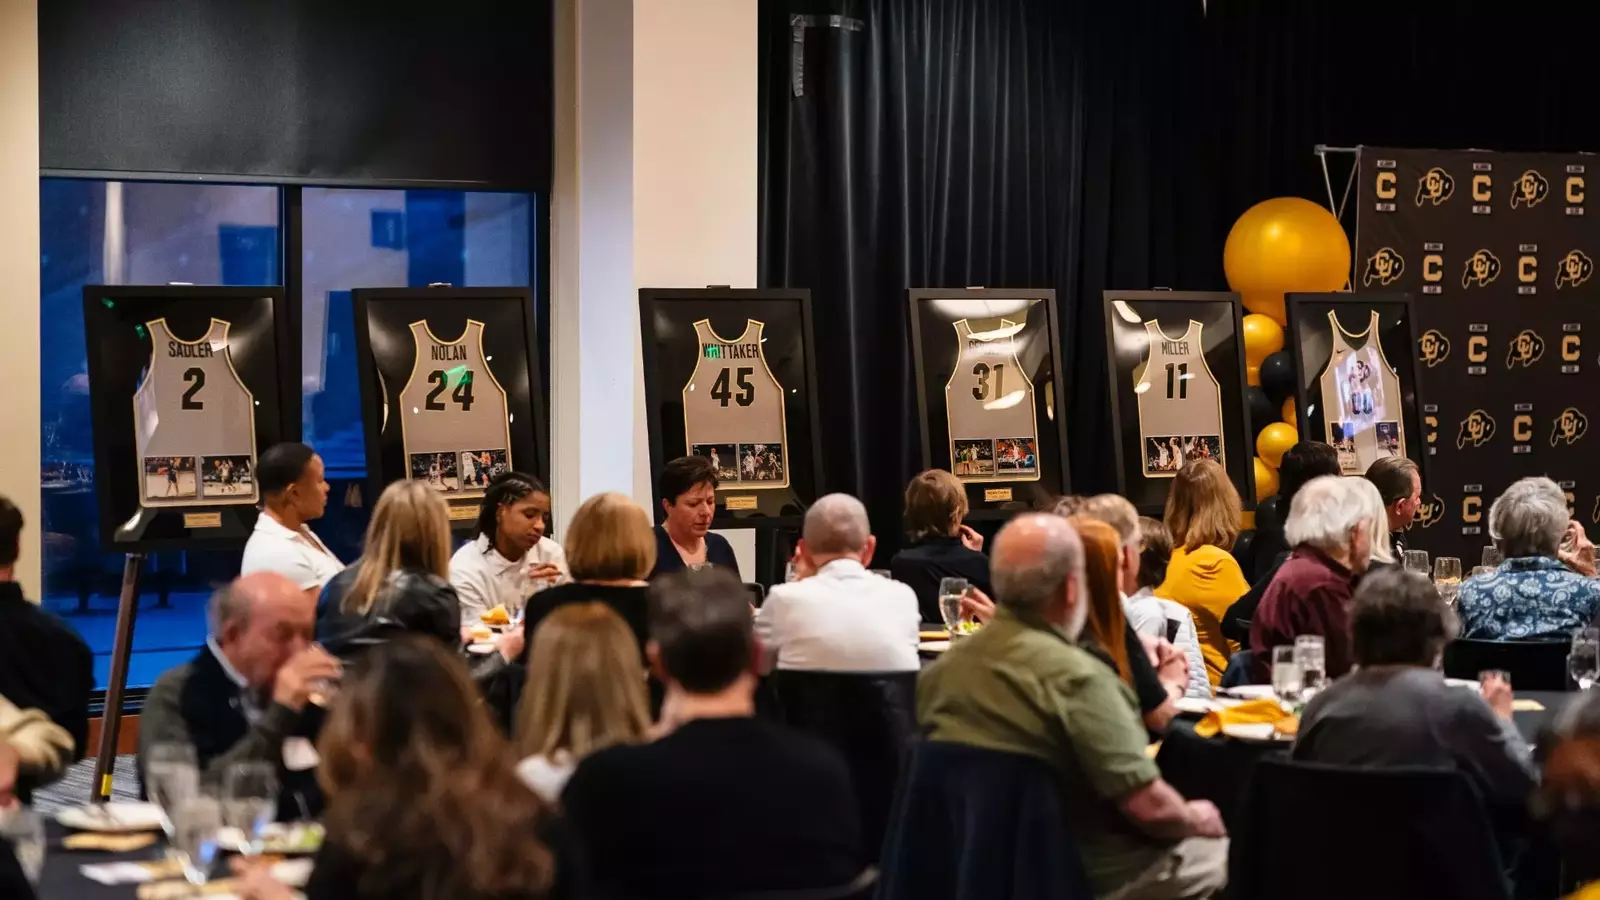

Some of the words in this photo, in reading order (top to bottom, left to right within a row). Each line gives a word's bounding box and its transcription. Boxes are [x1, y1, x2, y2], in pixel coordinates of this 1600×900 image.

[1376, 172, 1397, 199] C
[1472, 175, 1492, 202] C
[1565, 177, 1585, 203] C
[1423, 255, 1443, 282] C
[1518, 256, 1537, 282] C
[168, 341, 213, 357] SADLER
[431, 345, 467, 360] NOLAN
[702, 343, 760, 359] WHITTAKER
[1161, 341, 1190, 355] MILLER
[1468, 335, 1487, 362] C
[1562, 335, 1581, 361] C
[182, 367, 205, 410] 2
[425, 369, 475, 411] 24
[710, 367, 755, 408] 45
[972, 362, 1004, 401] 31
[1164, 362, 1188, 399] 11
[1513, 415, 1533, 441] C
[1462, 496, 1482, 522] C
